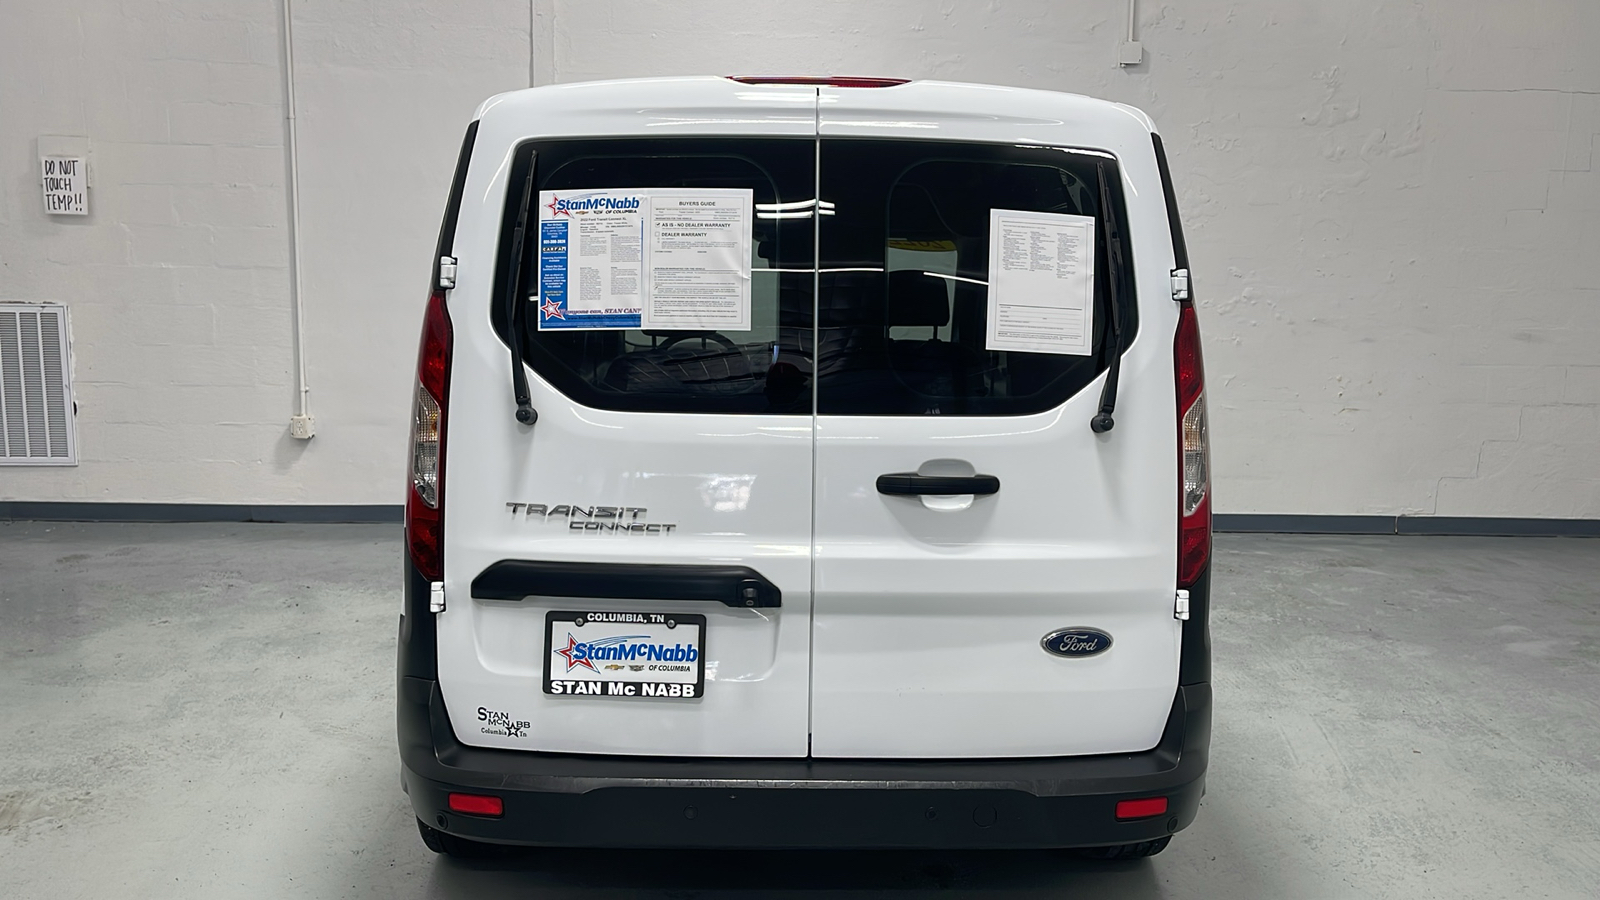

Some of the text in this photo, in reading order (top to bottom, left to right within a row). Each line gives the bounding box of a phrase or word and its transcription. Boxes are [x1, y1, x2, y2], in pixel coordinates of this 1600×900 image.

[45, 160, 79, 176] DO NOT
[44, 177, 72, 192] TOUCH
[45, 193, 82, 211] TEMP!!
[505, 502, 647, 520] TRANSIT
[569, 521, 677, 532] CONNECT
[587, 613, 665, 624] COLUMBIA, TN
[1060, 634, 1098, 651] Ford
[658, 664, 691, 672] COLUMBIA
[551, 680, 695, 698] STAN Mc NABB
[481, 727, 507, 736] Columbia
